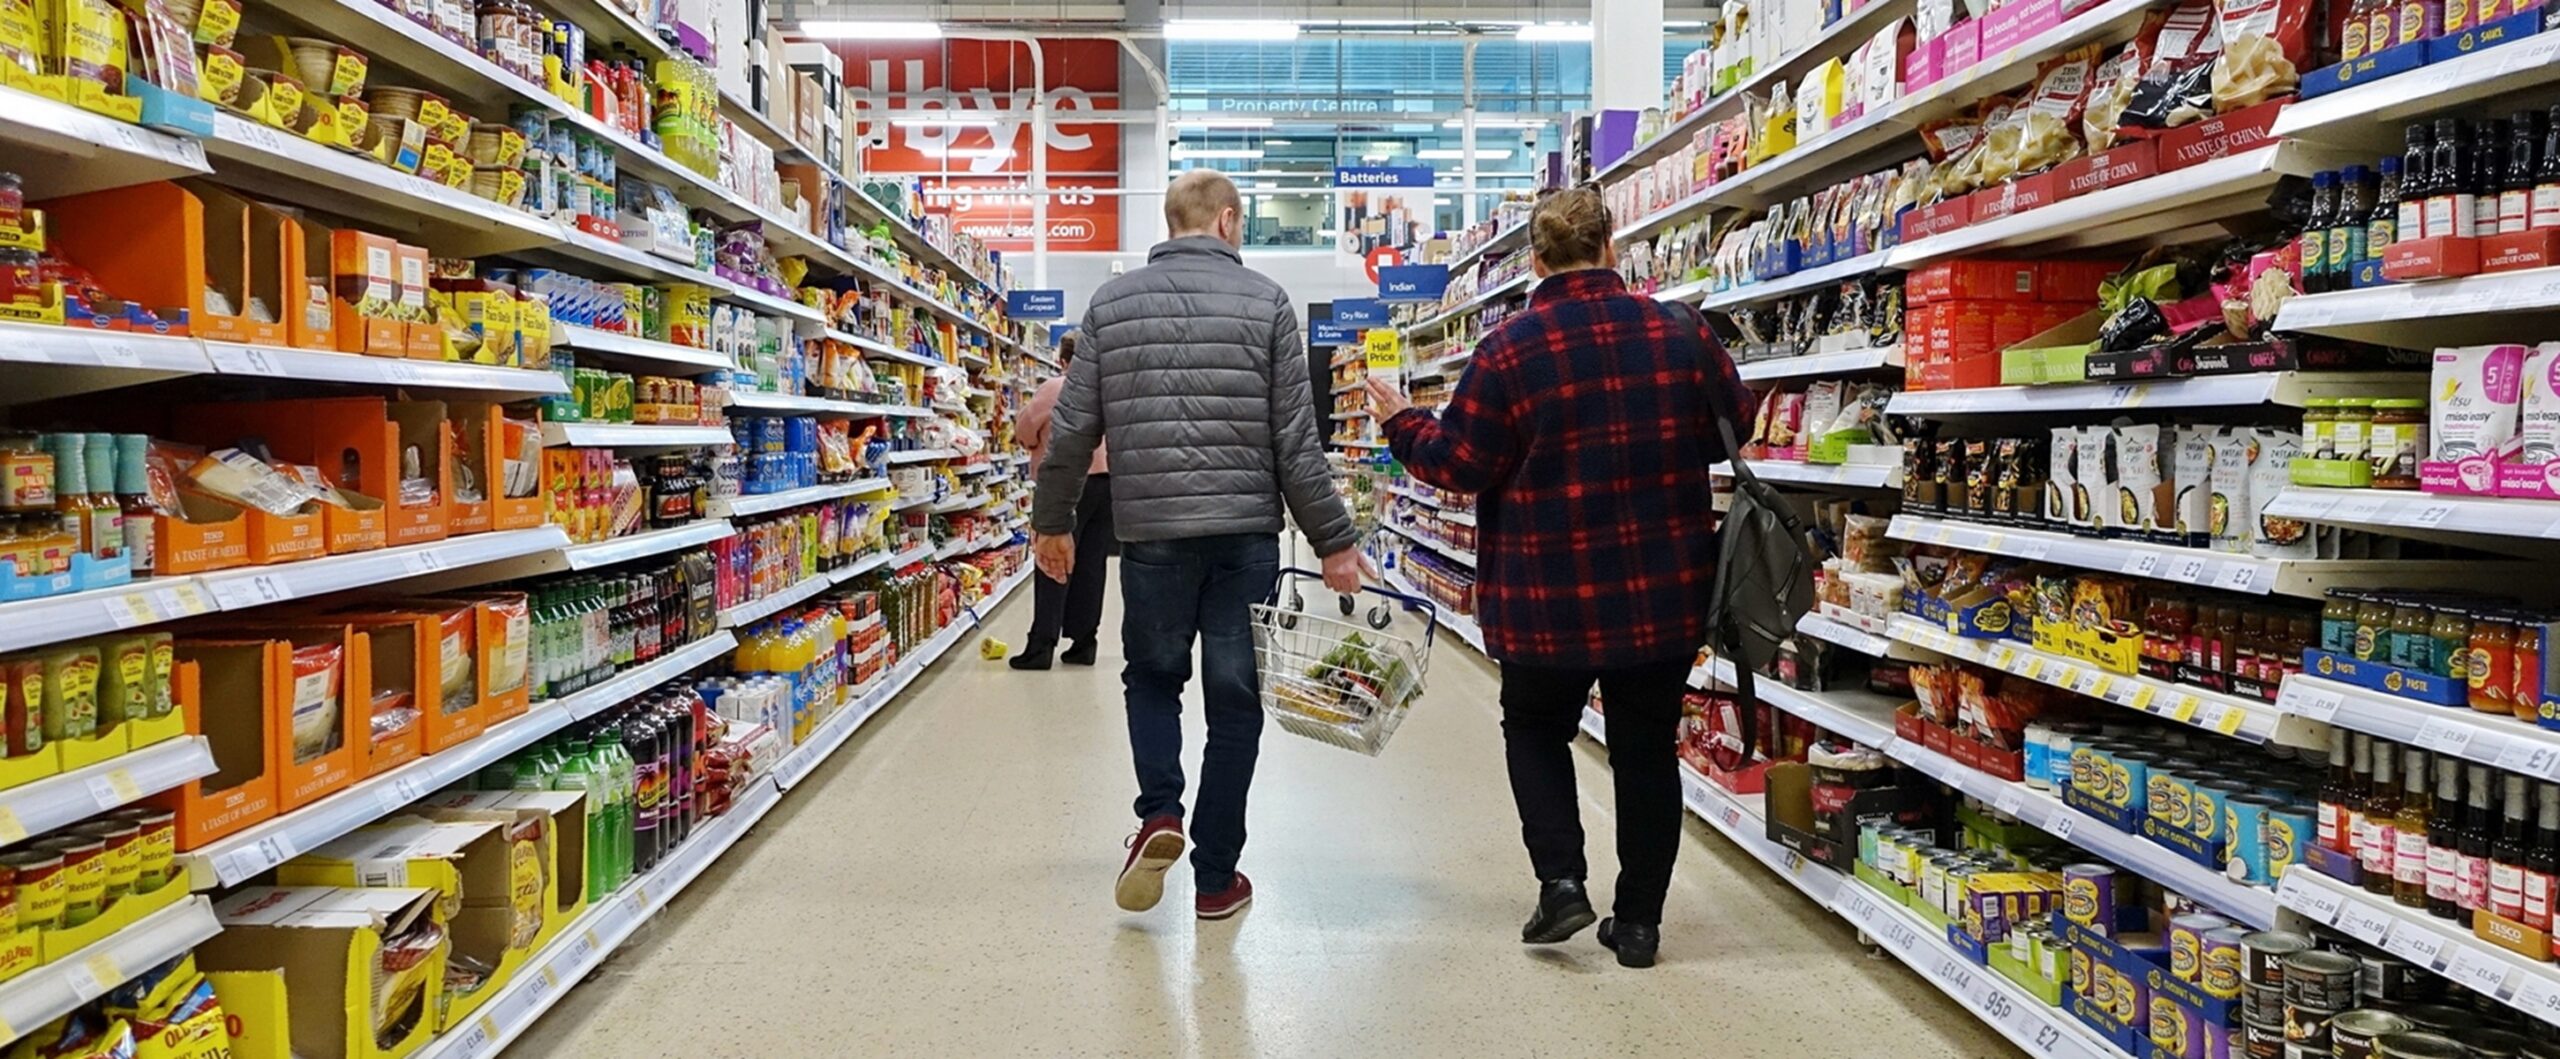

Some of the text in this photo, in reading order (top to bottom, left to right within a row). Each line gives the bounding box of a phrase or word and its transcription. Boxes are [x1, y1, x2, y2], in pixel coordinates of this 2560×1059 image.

[1222, 97, 1378, 113] Property Centre
[2200, 120, 2225, 136] TESCO
[2177, 148, 2186, 161] A
[2185, 140, 2215, 158] TASTE
[2230, 125, 2266, 147] CHINA
[1340, 171, 1399, 185] Batteries
[2111, 161, 2138, 180] CHINA
[1059, 184, 1095, 206] us
[1389, 282, 1416, 292] Indian
[1023, 303, 1056, 312] European
[1030, 294, 1056, 303] Eastern
[1341, 311, 1369, 321] Dry Rice
[1372, 342, 1392, 351] Half
[1369, 353, 1396, 362] Price
[2487, 366, 2499, 385] 5
[2419, 506, 2448, 523] £2
[172, 551, 181, 563] A
[181, 547, 207, 562] TASTE
[2183, 561, 2203, 579] £2
[2233, 568, 2252, 586] £2
[254, 576, 281, 600] £1
[2526, 748, 2556, 772] £1
[208, 812, 231, 830] TASTE
[2057, 815, 2073, 834] £2
[263, 840, 287, 865] £1
[1851, 898, 1875, 921] £1.45
[2362, 919, 2386, 935] £1.99
[2488, 920, 2523, 940] TESCO
[1888, 924, 1916, 950] £1.45
[1940, 961, 1971, 991] £1.44
[2476, 967, 2502, 985] £1.90
[1983, 990, 2012, 1020] 95p
[2036, 1025, 2060, 1052] £2
